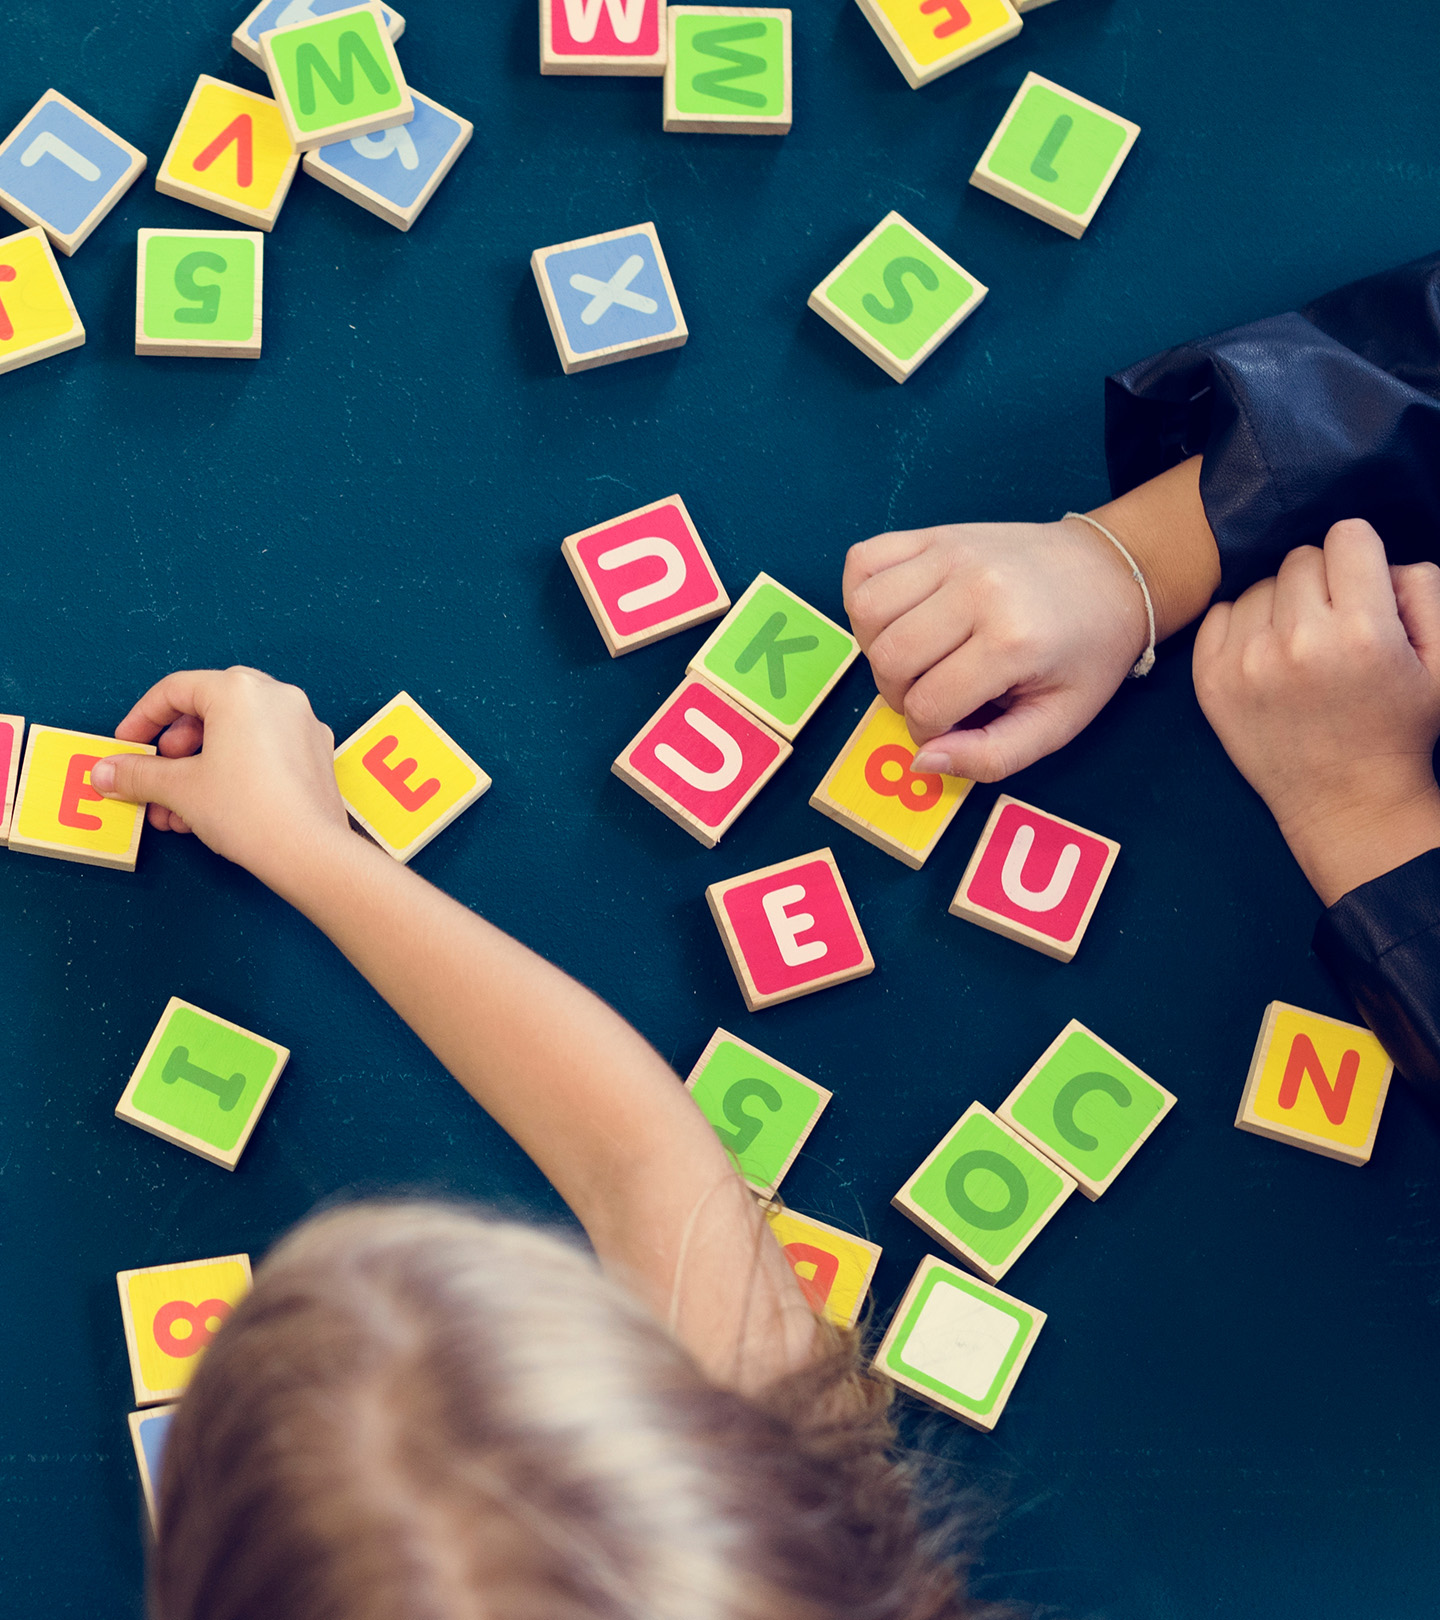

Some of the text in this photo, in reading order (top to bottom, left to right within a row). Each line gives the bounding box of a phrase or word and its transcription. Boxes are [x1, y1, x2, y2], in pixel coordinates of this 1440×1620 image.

[172, 250, 228, 326] 5
[569, 254, 658, 325] X
[861, 255, 940, 326] S
[598, 537, 687, 612] U
[734, 611, 820, 700] K
[362, 735, 441, 812] E
[654, 708, 743, 792] U
[864, 744, 944, 812] 8
[1001, 825, 1081, 912] U
[762, 885, 828, 966] E
[161, 1045, 247, 1112] I
[714, 1077, 783, 1155] 5
[1052, 1071, 1133, 1152] C
[1278, 1033, 1360, 1125] N
[944, 1149, 1030, 1232] O
[153, 1298, 235, 1358] 8
